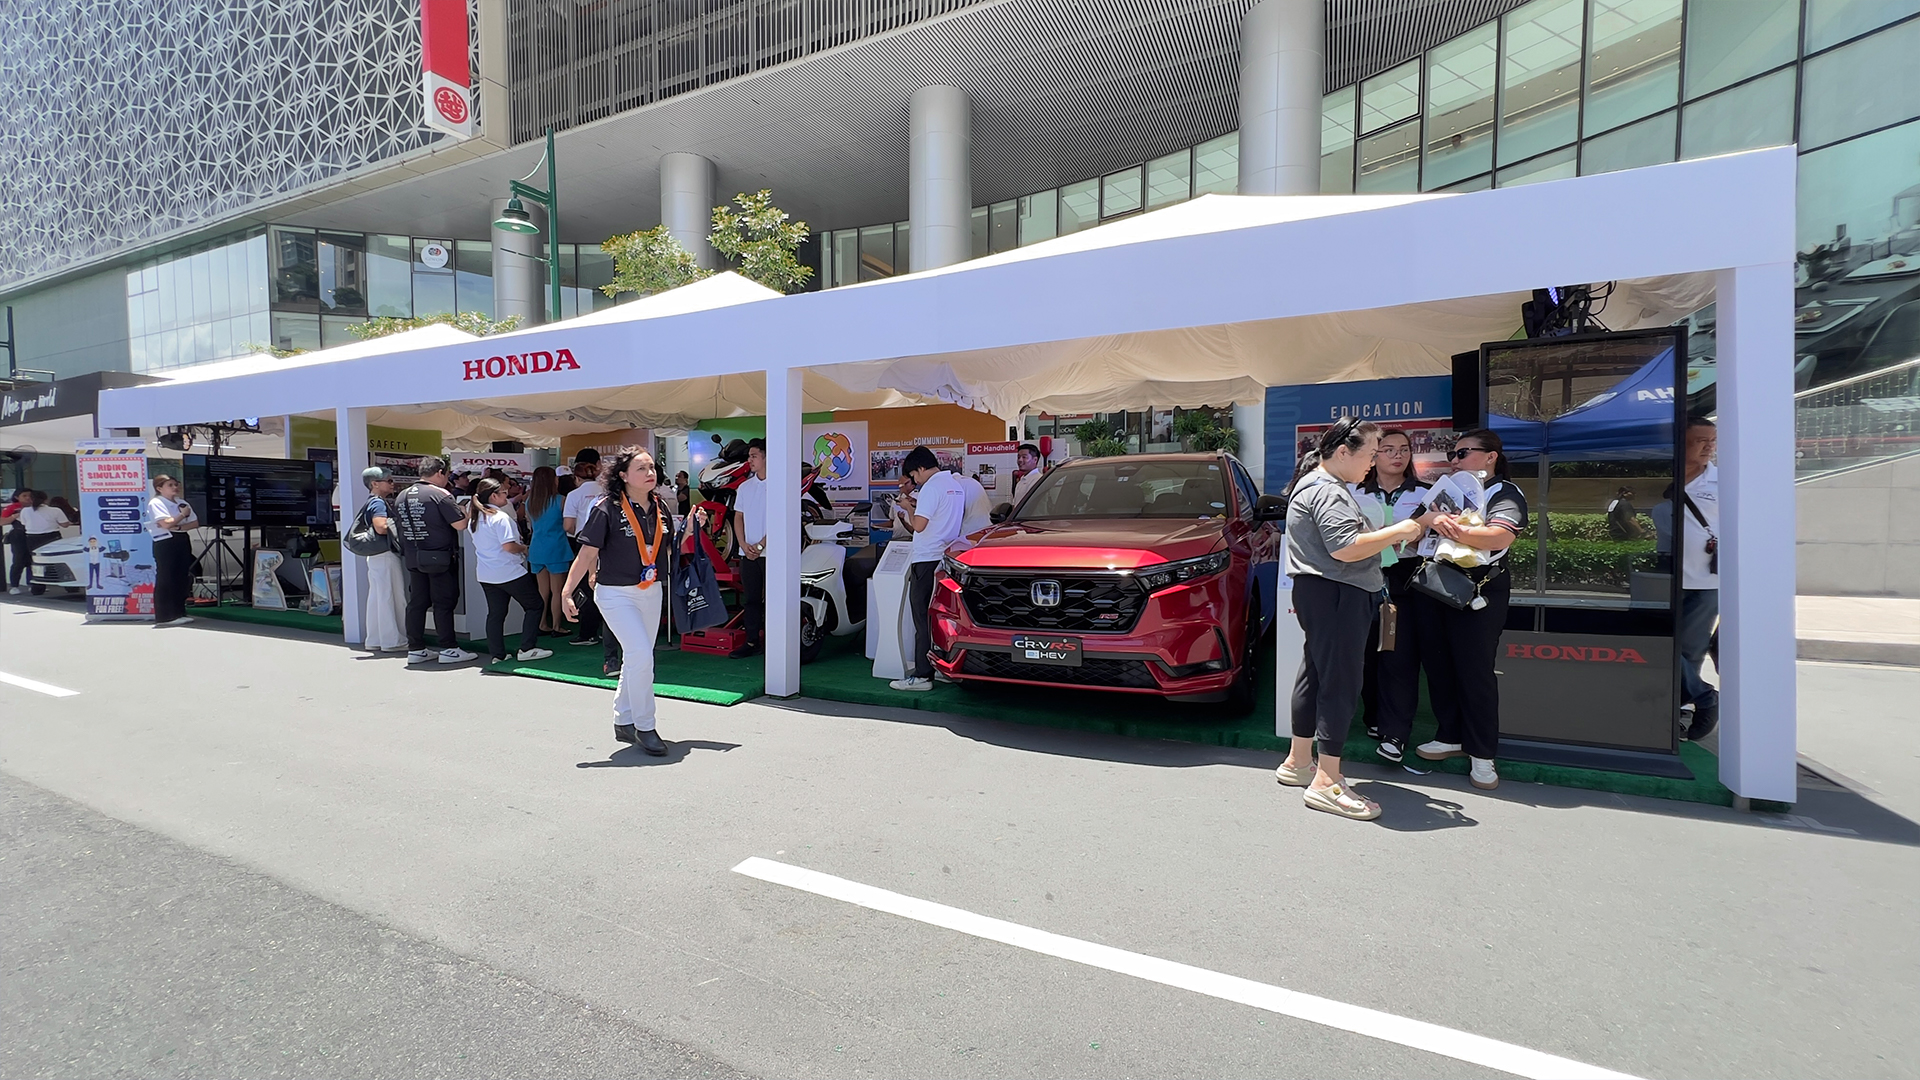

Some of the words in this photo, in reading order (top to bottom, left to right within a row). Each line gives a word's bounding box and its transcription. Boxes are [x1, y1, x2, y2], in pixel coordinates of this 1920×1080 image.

[462, 348, 581, 381] HONDA
[1330, 401, 1424, 419] EDUCATION
[369, 439, 408, 451] SAFETY
[913, 436, 950, 446] COMMUNITY
[971, 445, 982, 453] DC
[983, 443, 1016, 452] Handheld
[462, 458, 518, 466] HONDA
[97, 464, 128, 472] RIDING
[1505, 643, 1648, 664] HONDA
